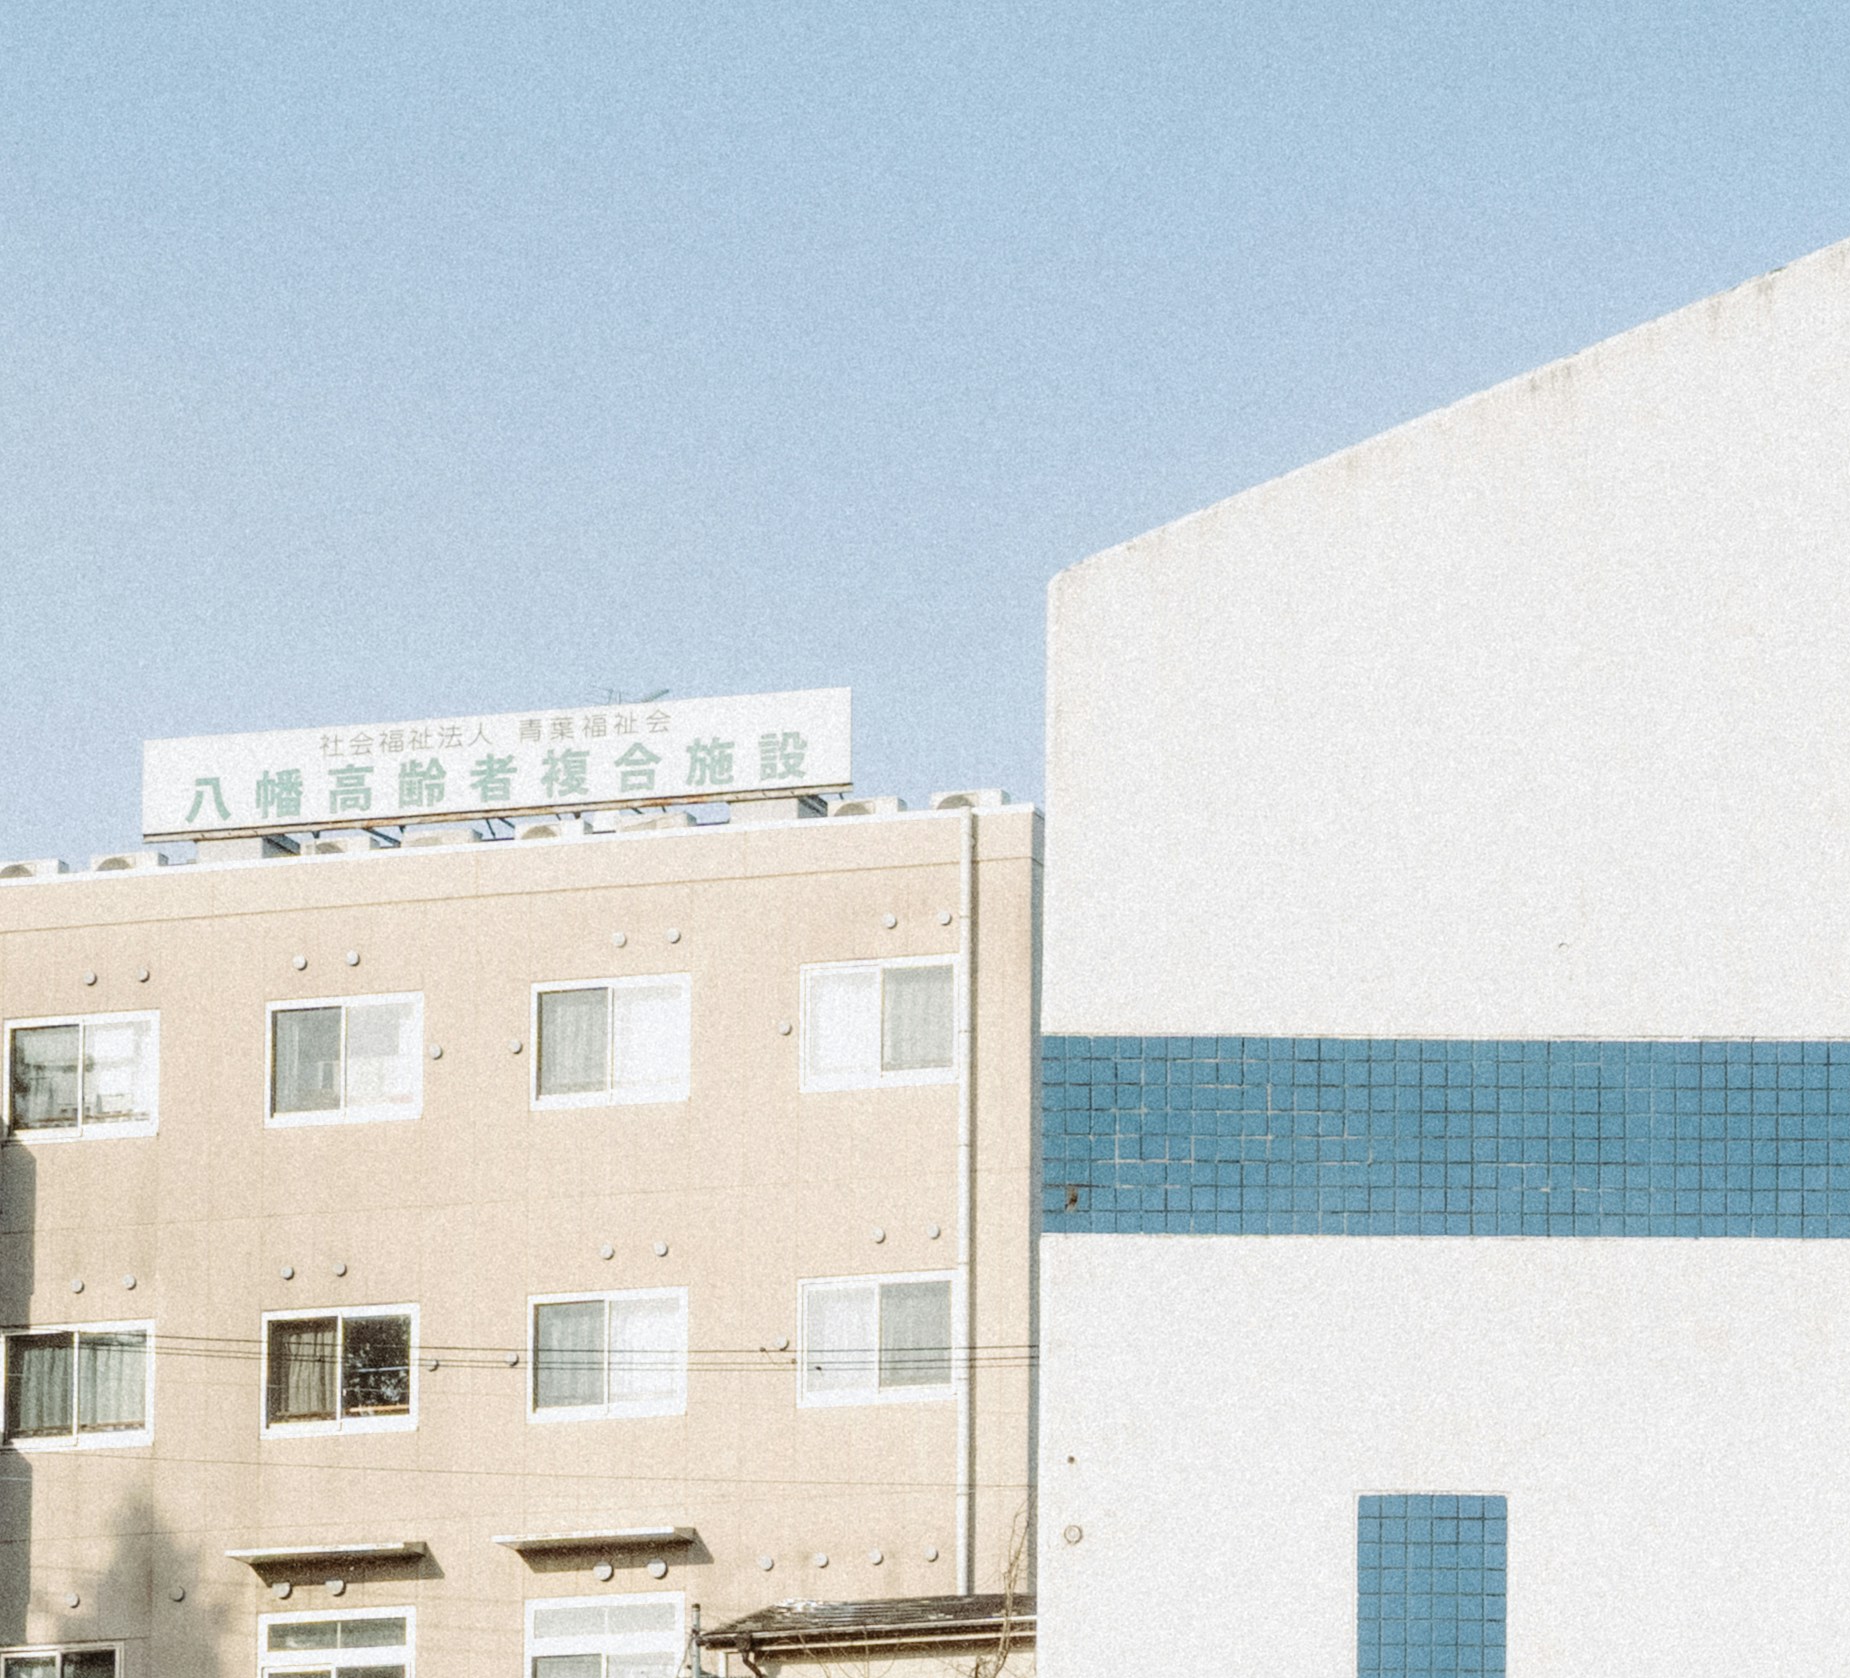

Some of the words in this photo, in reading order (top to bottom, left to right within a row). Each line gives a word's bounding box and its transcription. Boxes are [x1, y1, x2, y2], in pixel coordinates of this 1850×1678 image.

[318, 723, 494, 758] 社会福祉法人
[517, 708, 673, 744] 青葉福祉会
[184, 730, 808, 824] 八幡高齢者複合施設
